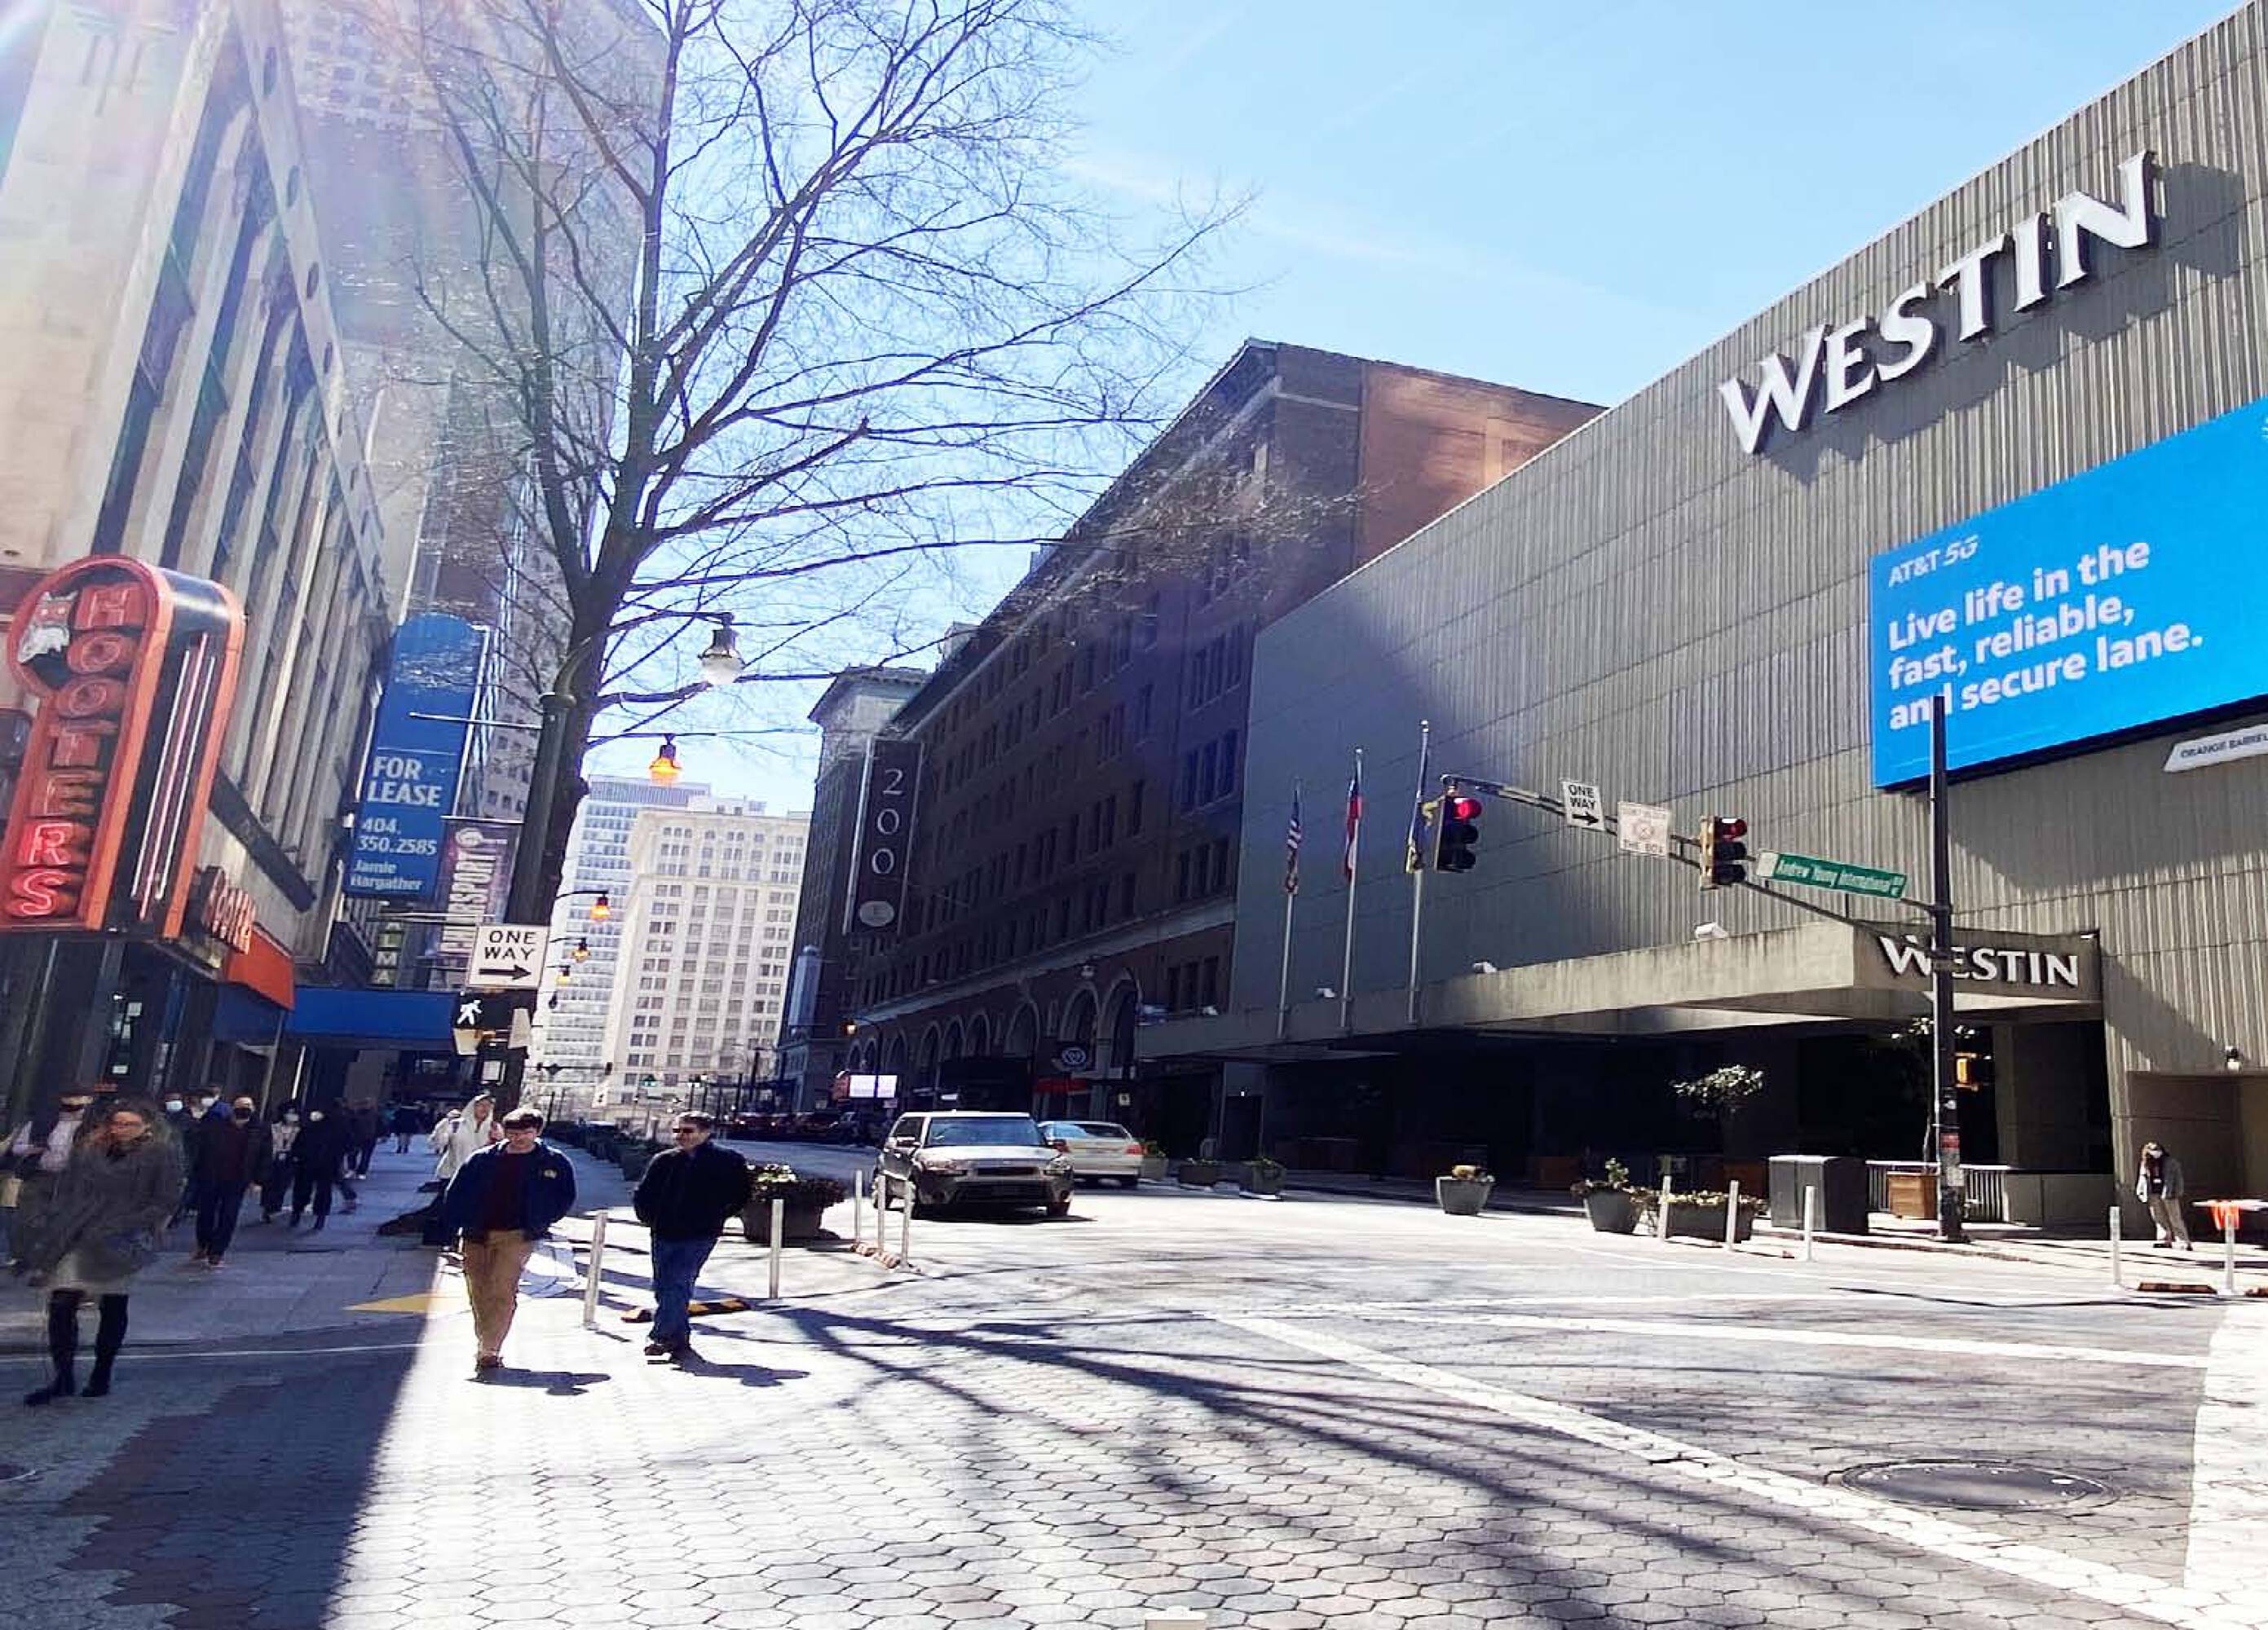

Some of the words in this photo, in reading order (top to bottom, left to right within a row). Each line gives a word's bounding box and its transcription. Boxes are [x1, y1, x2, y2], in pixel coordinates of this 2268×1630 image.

[1719, 150, 2155, 454] WESTIN
[1888, 549, 1940, 588] AT&T
[1888, 607, 1956, 651] Live
[1966, 582, 2023, 625] life
[2033, 567, 2069, 601] in
[2077, 542, 2150, 586] the
[1888, 645, 1966, 690] fast,
[1975, 593, 2134, 665] reliable,
[1961, 652, 2087, 710] secure
[2097, 623, 2203, 672] lane.
[10, 582, 145, 918] HOOTERS
[373, 756, 422, 780] FOR
[367, 782, 443, 807] LEASE
[1568, 784, 1595, 798] ONE
[1569, 796, 1596, 809] WAY
[871, 768, 903, 874] 200
[483, 946, 536, 960] WAY
[488, 930, 537, 945] ONE
[1878, 935, 2079, 988] WESTIN
